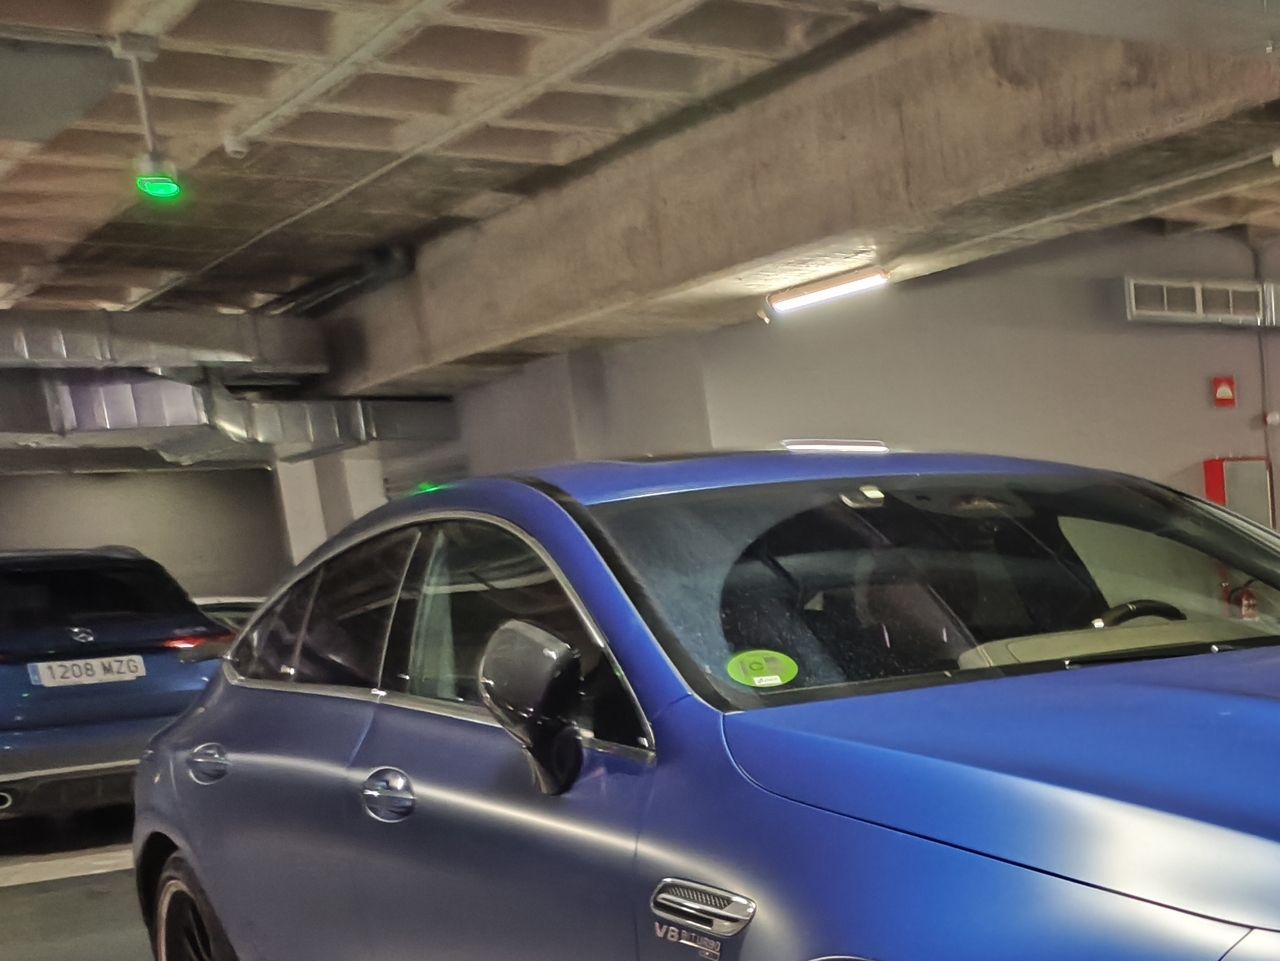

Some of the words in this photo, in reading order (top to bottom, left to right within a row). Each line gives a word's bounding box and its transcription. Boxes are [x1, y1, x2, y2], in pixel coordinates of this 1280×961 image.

[47, 662, 96, 681] 1208
[100, 658, 139, 676] MZG
[654, 921, 679, 942] V8
